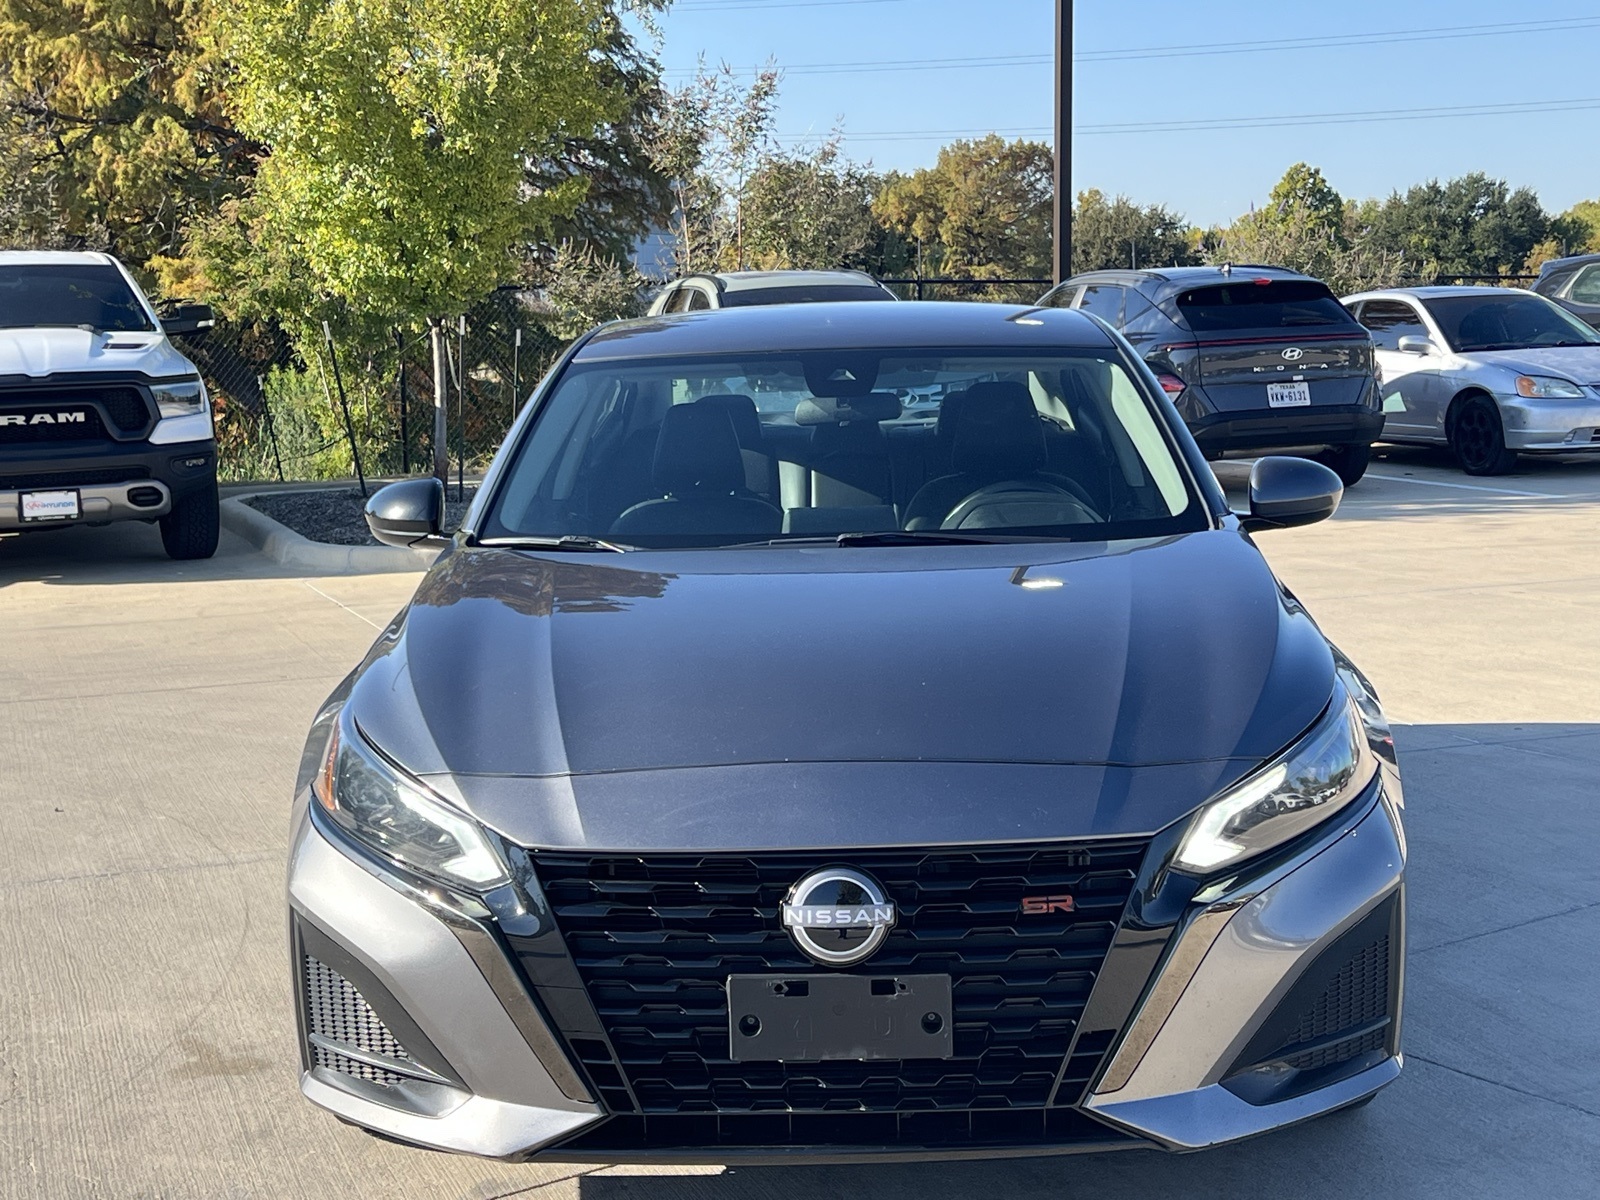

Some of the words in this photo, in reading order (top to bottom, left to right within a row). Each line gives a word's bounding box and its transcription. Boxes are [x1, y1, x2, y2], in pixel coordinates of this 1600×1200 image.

[1253, 363, 1328, 372] KONA
[0, 412, 85, 426] RAM
[1022, 894, 1075, 915] SR
[786, 907, 892, 925] NISSAN
